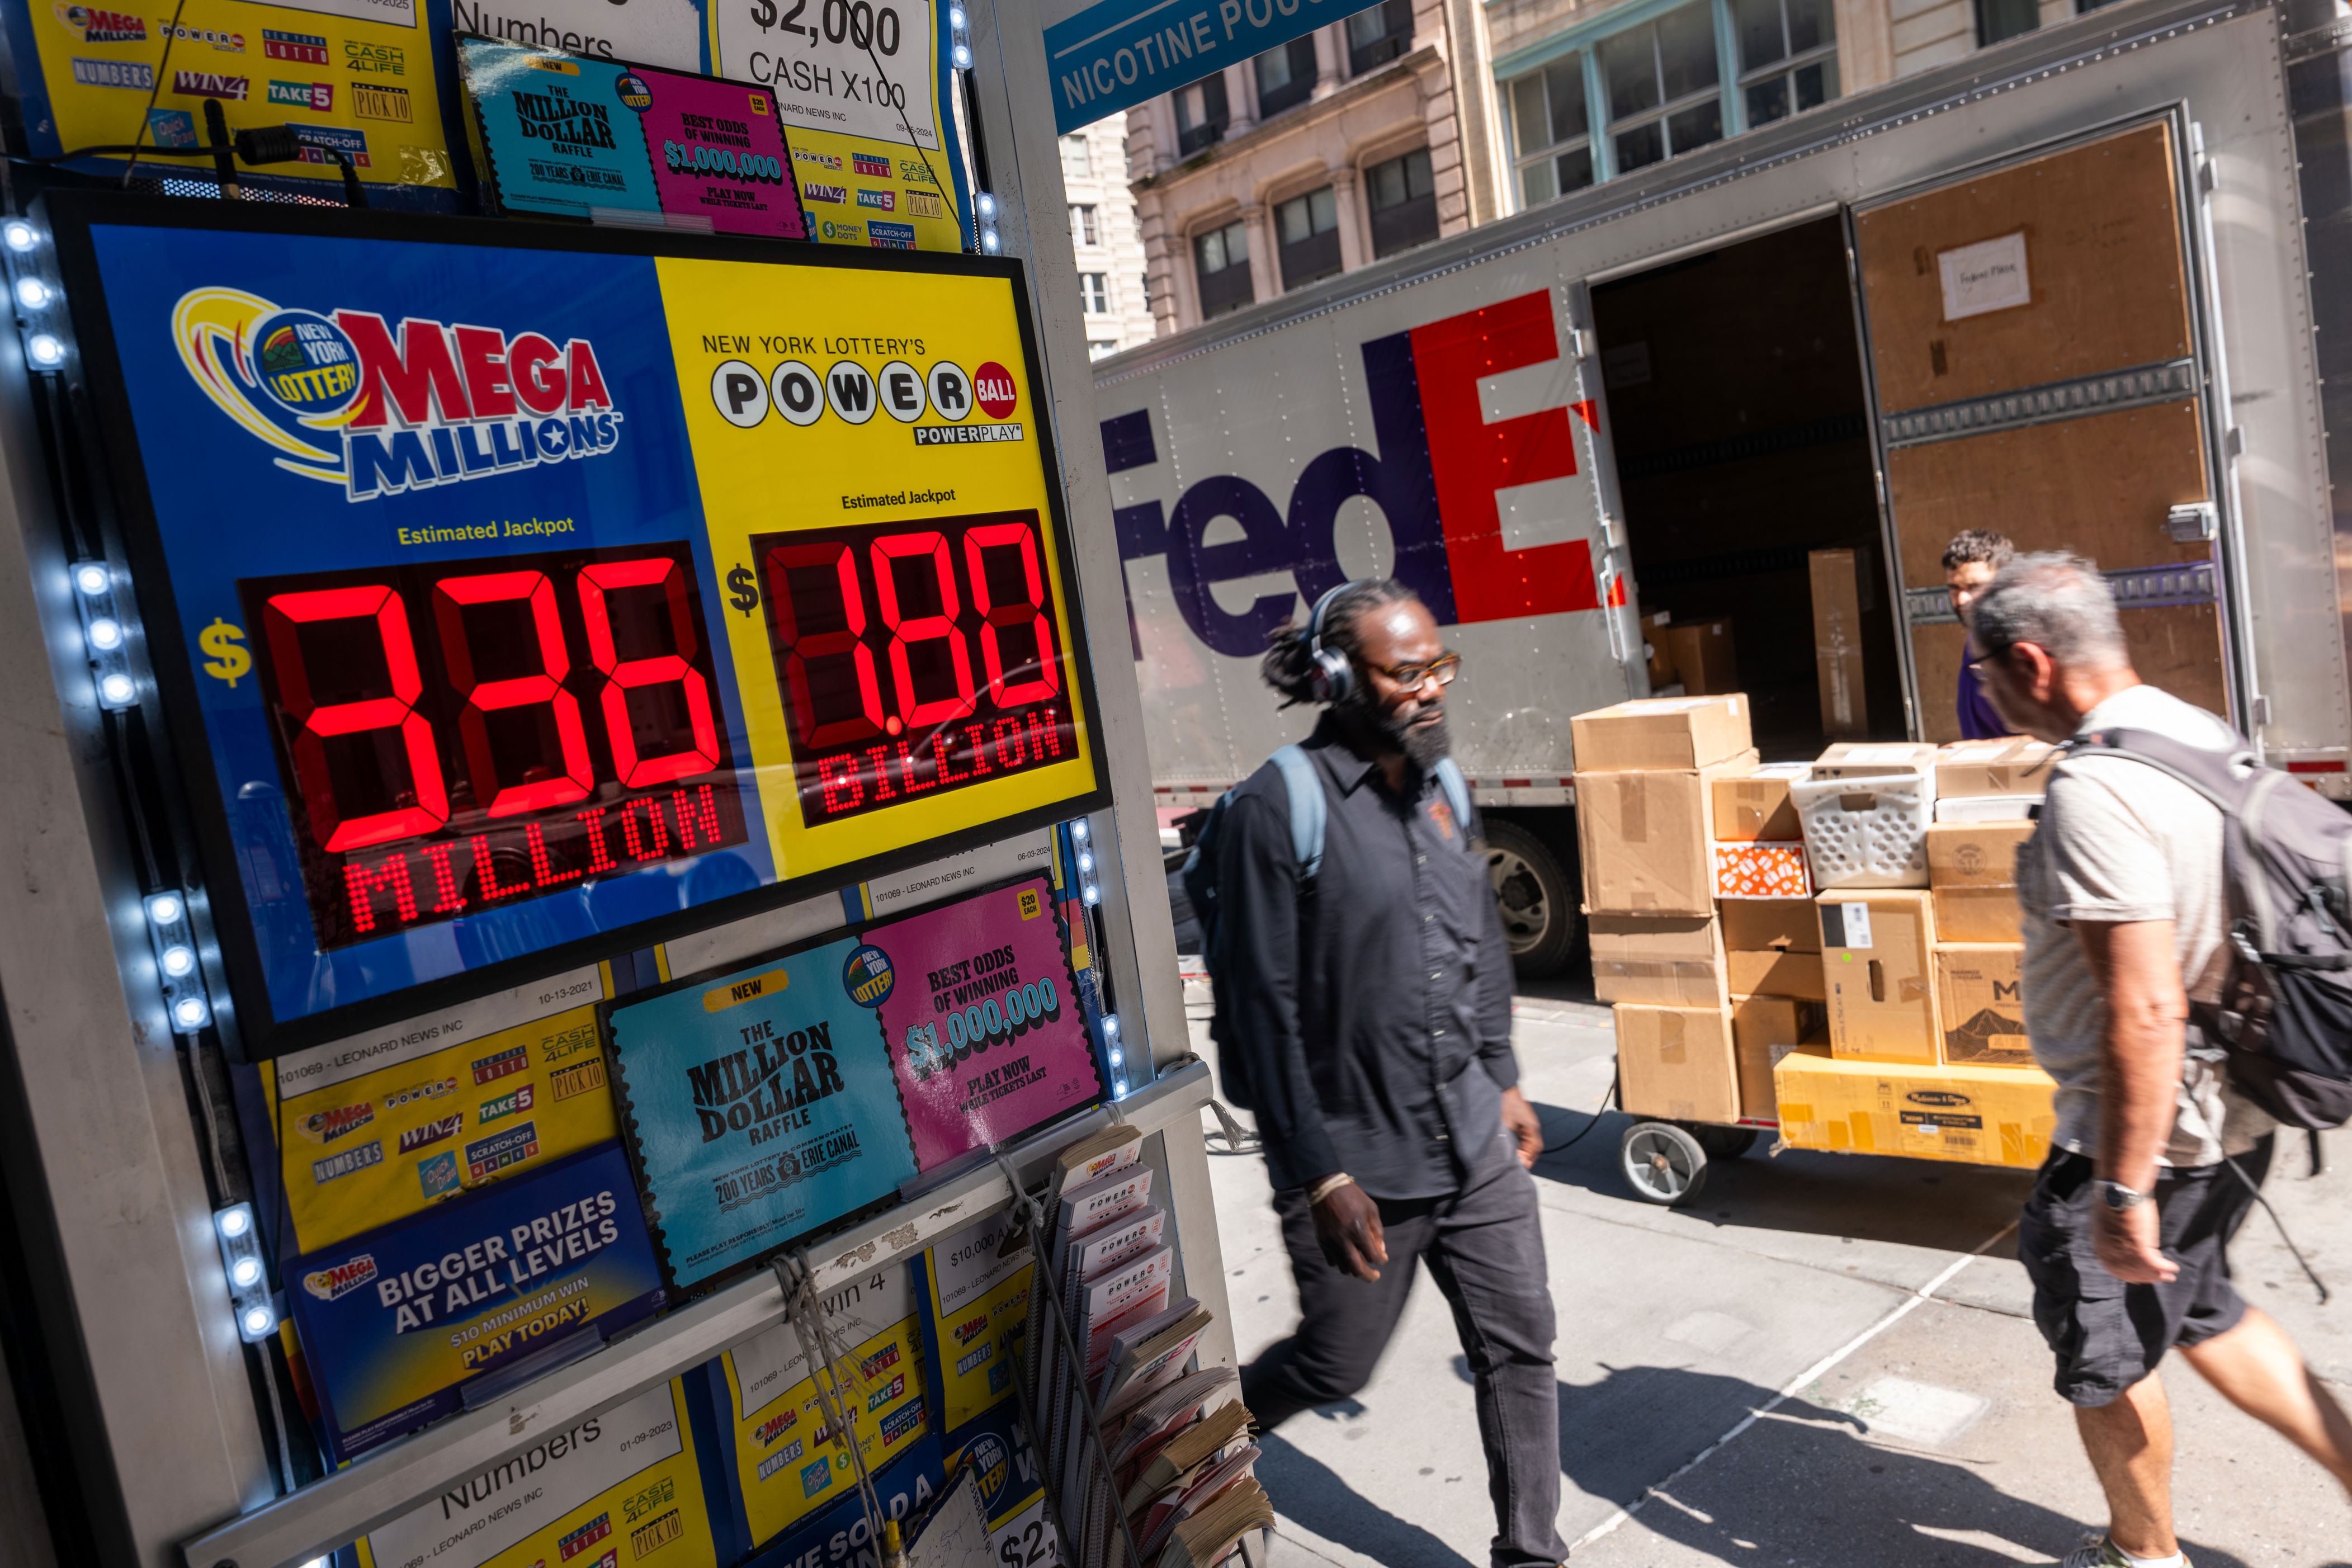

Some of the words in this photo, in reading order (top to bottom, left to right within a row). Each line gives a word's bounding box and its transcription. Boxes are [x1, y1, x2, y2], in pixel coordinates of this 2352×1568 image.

[86, 8, 146, 31] MEGA
[455, 1, 613, 58] Numbers
[750, 0, 900, 56] $2,000
[266, 42, 327, 63] LOTTO
[344, 44, 404, 63] CASH
[346, 59, 405, 75] 4LIFE
[1061, 11, 1216, 109] NICOTINE
[74, 58, 153, 89] NUMBERS
[177, 70, 226, 92] WIN
[224, 75, 249, 101] 4
[749, 51, 833, 97] CASH
[840, 70, 906, 111] X100
[268, 84, 311, 103] TAKE
[314, 88, 330, 106] 5
[356, 89, 387, 117] PICK
[388, 96, 409, 120] 10
[547, 85, 570, 98] THE
[512, 91, 610, 124] MILLION
[517, 115, 617, 149] DOLLAR
[681, 112, 715, 133] BEST
[716, 119, 749, 135] ODDS
[684, 128, 700, 142] OF
[700, 131, 752, 149] WINNING
[552, 142, 594, 158] RAFFLE
[664, 139, 782, 183] $1,000,000
[854, 164, 890, 177] LOTTO
[899, 163, 935, 176] CASH
[706, 186, 733, 199] PLAY
[734, 190, 755, 202] NOW
[837, 224, 862, 234] MONEY
[838, 232, 858, 240] DOTS
[871, 228, 912, 239] SCRATCH-OFF
[295, 323, 332, 342] NEW
[702, 336, 750, 354] NEW
[759, 337, 817, 354] YORK
[826, 337, 926, 356] LOTTERY'S
[304, 339, 350, 365] YORK
[268, 361, 357, 403] LOTTERY
[337, 310, 613, 428] MEGA
[350, 414, 617, 499] MILLIONS
[841, 491, 906, 509] Estimated
[909, 488, 956, 505] Jackpot
[398, 521, 498, 545] Estimated
[503, 517, 575, 537] Jackpot
[199, 617, 252, 688] $
[818, 708, 1061, 814] BILLION
[342, 784, 722, 932] MILLION
[1017, 846, 1051, 862] 06-03-2024
[876, 888, 901, 903] 101069
[906, 875, 940, 895] LEONARD
[941, 870, 962, 883] NEWS
[962, 866, 975, 879] INC
[1021, 894, 1036, 907] $20
[1023, 904, 1037, 915] EACH
[862, 949, 880, 964] NEW
[866, 956, 889, 976] YORK
[927, 958, 972, 993] BEST
[973, 944, 1016, 976] ODDS
[538, 980, 594, 1005] 10-13-2021
[730, 979, 762, 1002] NEW
[852, 970, 893, 1004] LOTTERY
[933, 991, 952, 1014] OF
[953, 966, 1019, 1007] WINNING
[740, 1020, 775, 1046] THE
[906, 976, 1059, 1069] $1,000,000
[279, 1062, 324, 1085] 101069
[335, 1038, 399, 1069] LEONARD
[401, 1027, 440, 1049] NEWS
[442, 1021, 464, 1038] INC
[541, 1027, 595, 1052] CASH
[544, 1036, 596, 1062] 4LIFE
[474, 1056, 527, 1085] LOTTO
[686, 1021, 834, 1107] MILLION
[967, 1068, 1000, 1096] PLAY
[1001, 1055, 1031, 1082] NOW
[555, 1071, 587, 1098] PICK
[588, 1066, 602, 1086] 10
[695, 1051, 845, 1144] DOLLAR
[958, 1095, 989, 1114] WHILE
[989, 1077, 1026, 1102] TICKETS
[1026, 1066, 1047, 1085] LAST
[322, 1101, 374, 1131] MEGA
[480, 1097, 517, 1120] TAKE
[518, 1088, 532, 1107] 5
[401, 1121, 446, 1147] WIN
[443, 1112, 464, 1138] 4
[748, 1108, 811, 1146] RAFFLE
[790, 1123, 853, 1152] COMMEMORATES
[470, 1130, 533, 1161] SCRATCH-OFF
[473, 1146, 536, 1175] GAMES
[801, 1144, 826, 1169] ERIE
[826, 1130, 861, 1159] CANAL
[315, 1144, 382, 1184] NUMBERS
[426, 1157, 450, 1184] Quick
[436, 1165, 457, 1192] Draw
[715, 1178, 740, 1204] 200
[739, 1164, 776, 1194] YEARS
[1090, 1189, 1126, 1210] POWER
[377, 1235, 508, 1308] BIGGER
[511, 1189, 616, 1253] PRIZES
[951, 1232, 994, 1268] $10,000
[1102, 1230, 1137, 1253] POWER
[329, 1257, 375, 1287] MEGA
[330, 1269, 377, 1301] MILLIONS
[395, 1297, 435, 1335] AT
[446, 1264, 506, 1314] ALL
[508, 1218, 618, 1284] LEVELS
[1108, 1270, 1145, 1295] POWER
[451, 1327, 480, 1349] $10
[482, 1290, 557, 1331] MINIMUM
[558, 1276, 589, 1297] WIN
[962, 1314, 988, 1335] MEGA
[461, 1331, 512, 1370] PLAY
[516, 1296, 591, 1343] TODAY!
[957, 1343, 992, 1378] NUMBERS
[868, 1386, 892, 1410] TAKE
[894, 1379, 904, 1395] 5
[763, 1409, 797, 1435] MEGA
[884, 1401, 923, 1433] SCRATCH-OFF
[619, 1420, 673, 1453] 01-09-2023
[974, 1437, 995, 1457] NEW
[759, 1443, 802, 1479] NUMBERS
[807, 1462, 824, 1487] Quick
[976, 1451, 1004, 1475] YORK
[622, 1481, 675, 1513] CASH
[625, 1491, 676, 1524] 4LIFE
[969, 1479, 983, 1517] 235830
[981, 1525, 990, 1543] INT
[433, 1518, 487, 1557] LEONARD
[488, 1499, 523, 1522] NEWS
[523, 1487, 544, 1505] INC
[561, 1522, 612, 1561] LOTTO
